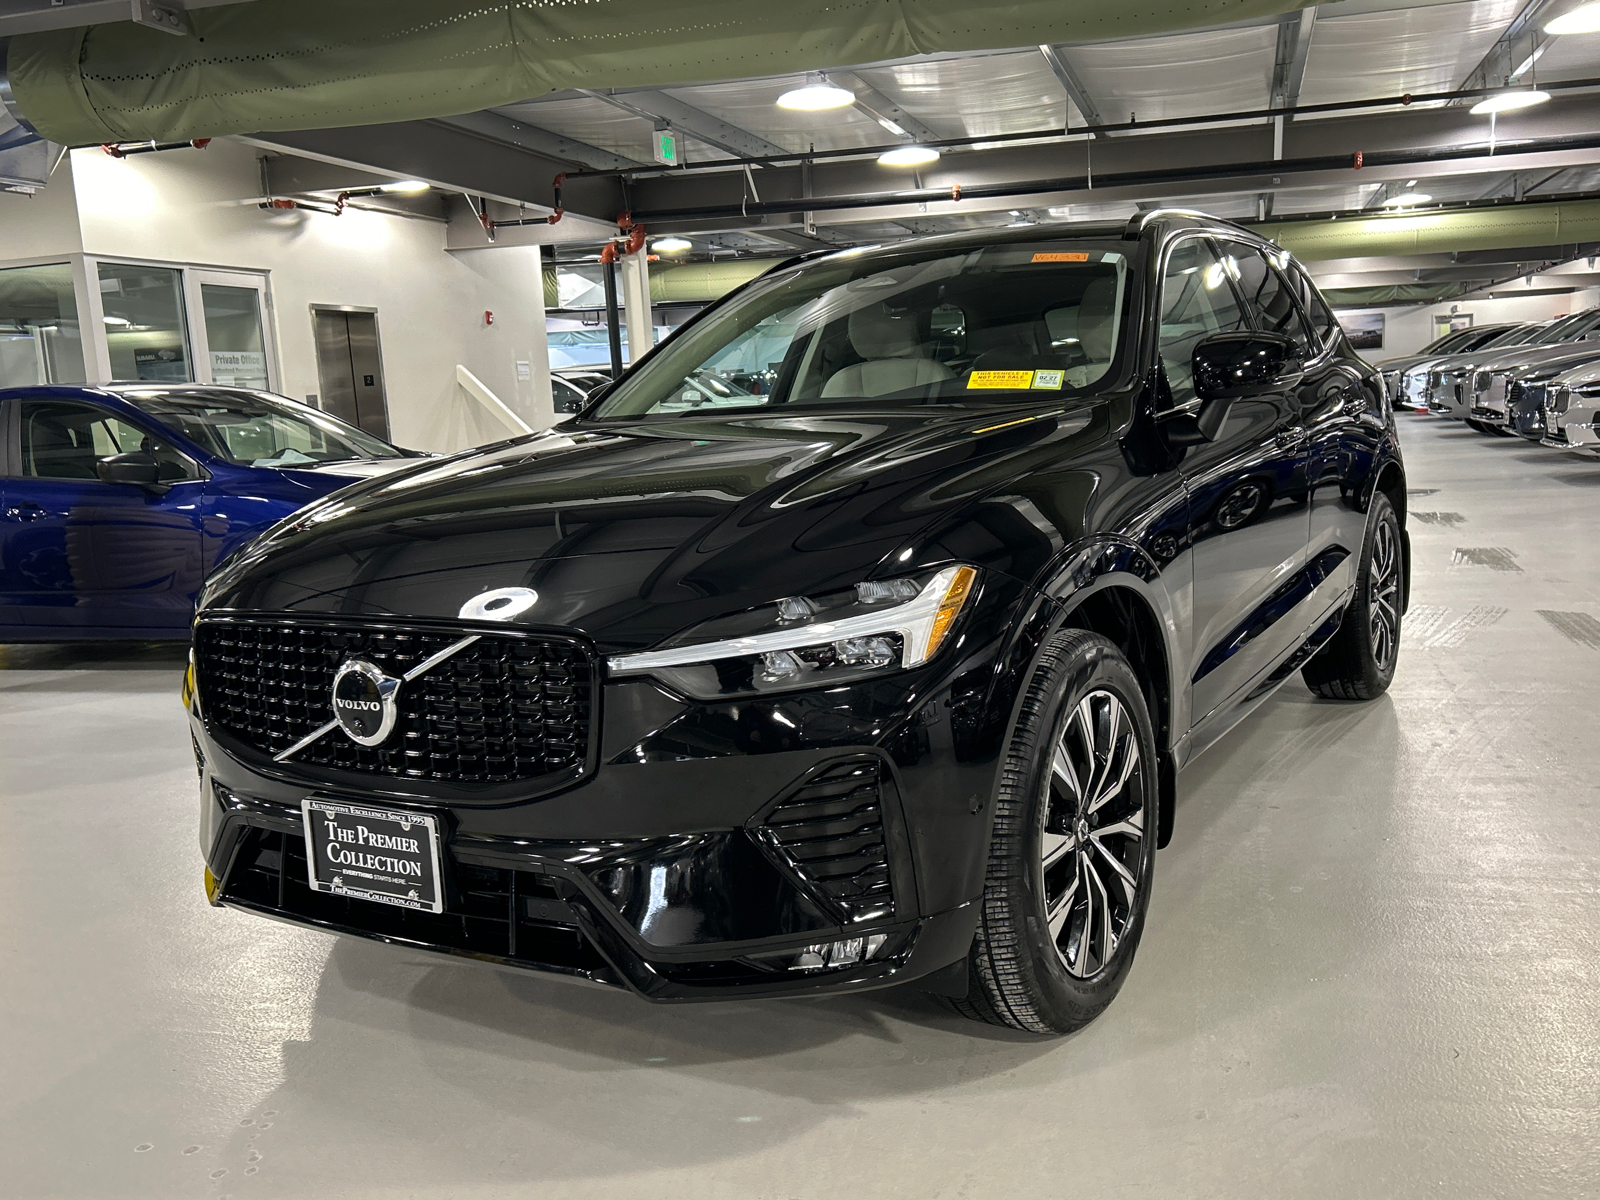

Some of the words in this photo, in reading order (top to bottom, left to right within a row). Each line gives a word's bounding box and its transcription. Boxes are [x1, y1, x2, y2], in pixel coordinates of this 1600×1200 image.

[215, 354, 240, 364] Private
[240, 354, 260, 364] Office
[336, 698, 380, 711] VOLVO
[408, 816, 426, 824] 1995
[324, 820, 356, 844] THE
[356, 826, 420, 854] PREMIER
[326, 842, 422, 876] COLLECTION
[342, 868, 374, 880] EVERYTHING
[374, 874, 392, 882] STARTS
